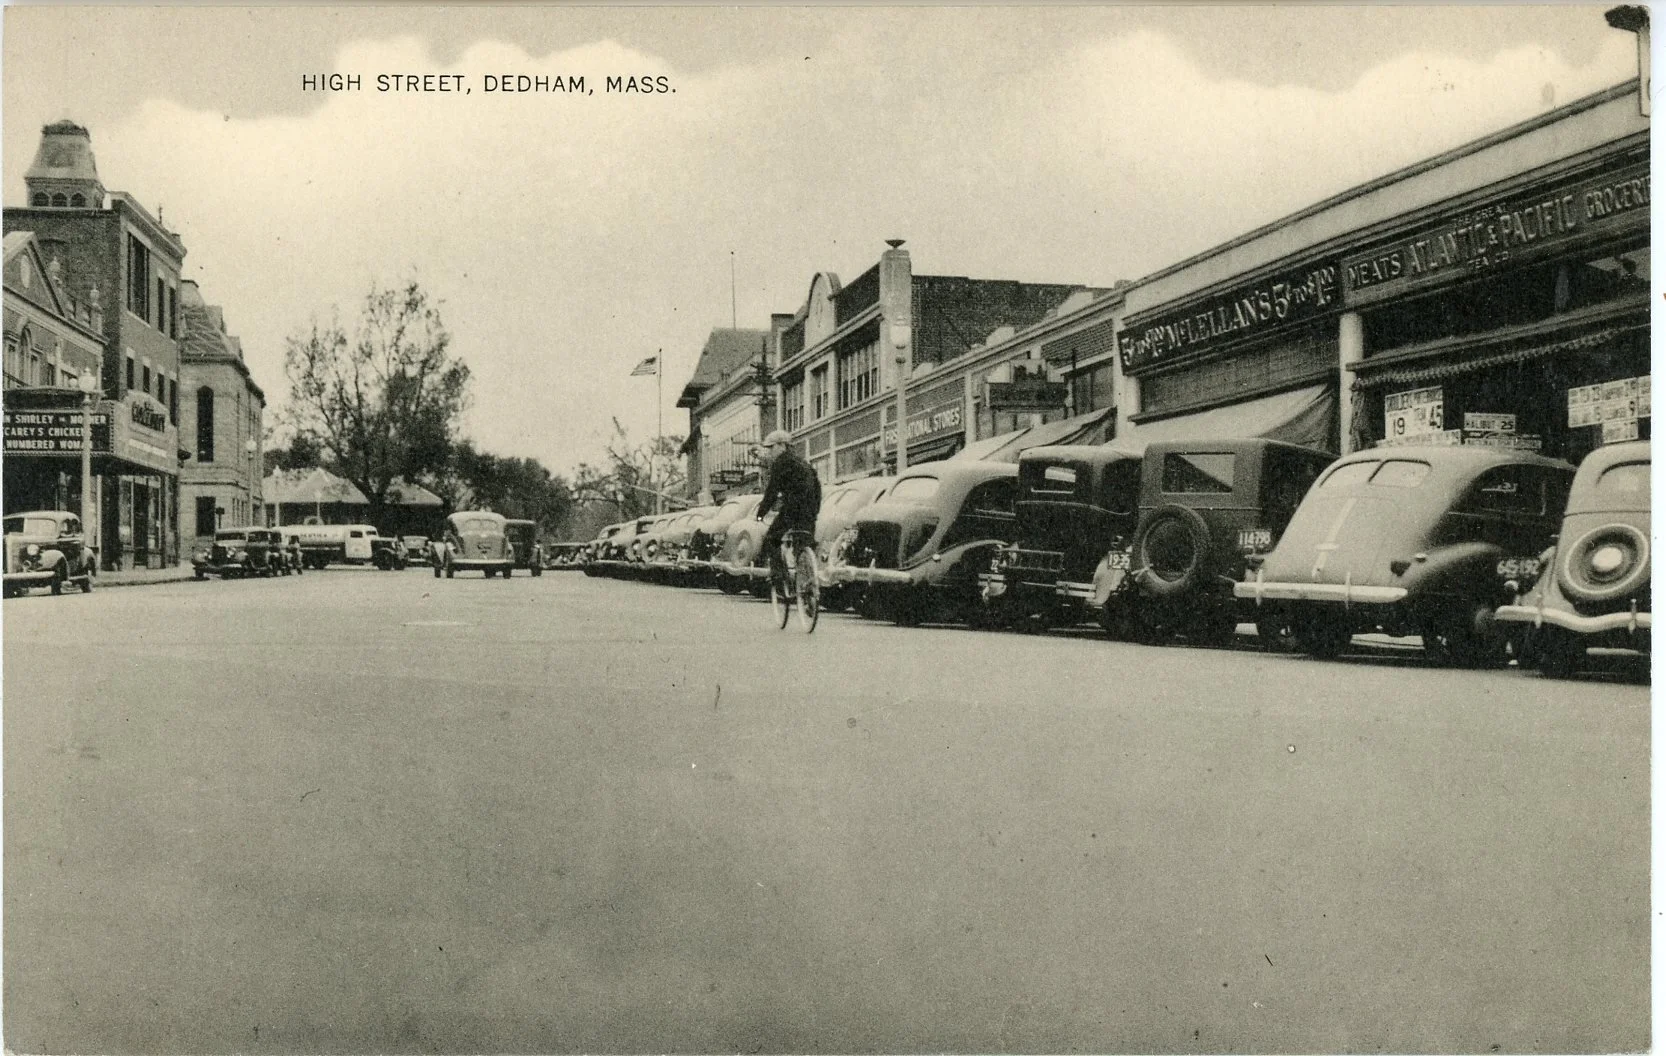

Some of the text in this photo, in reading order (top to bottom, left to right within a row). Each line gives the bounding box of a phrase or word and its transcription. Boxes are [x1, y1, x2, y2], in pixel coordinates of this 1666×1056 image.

[1410, 222, 1487, 273] ATLANTIC
[1499, 194, 1577, 247] PACIFIC
[1348, 253, 1402, 287] MEATS
[15, 414, 54, 424] SHIRLEY
[70, 415, 107, 425] MOHER
[1393, 417, 1405, 437] 19
[1500, 420, 1515, 430] 25
[6, 440, 55, 449] NUMBERED
